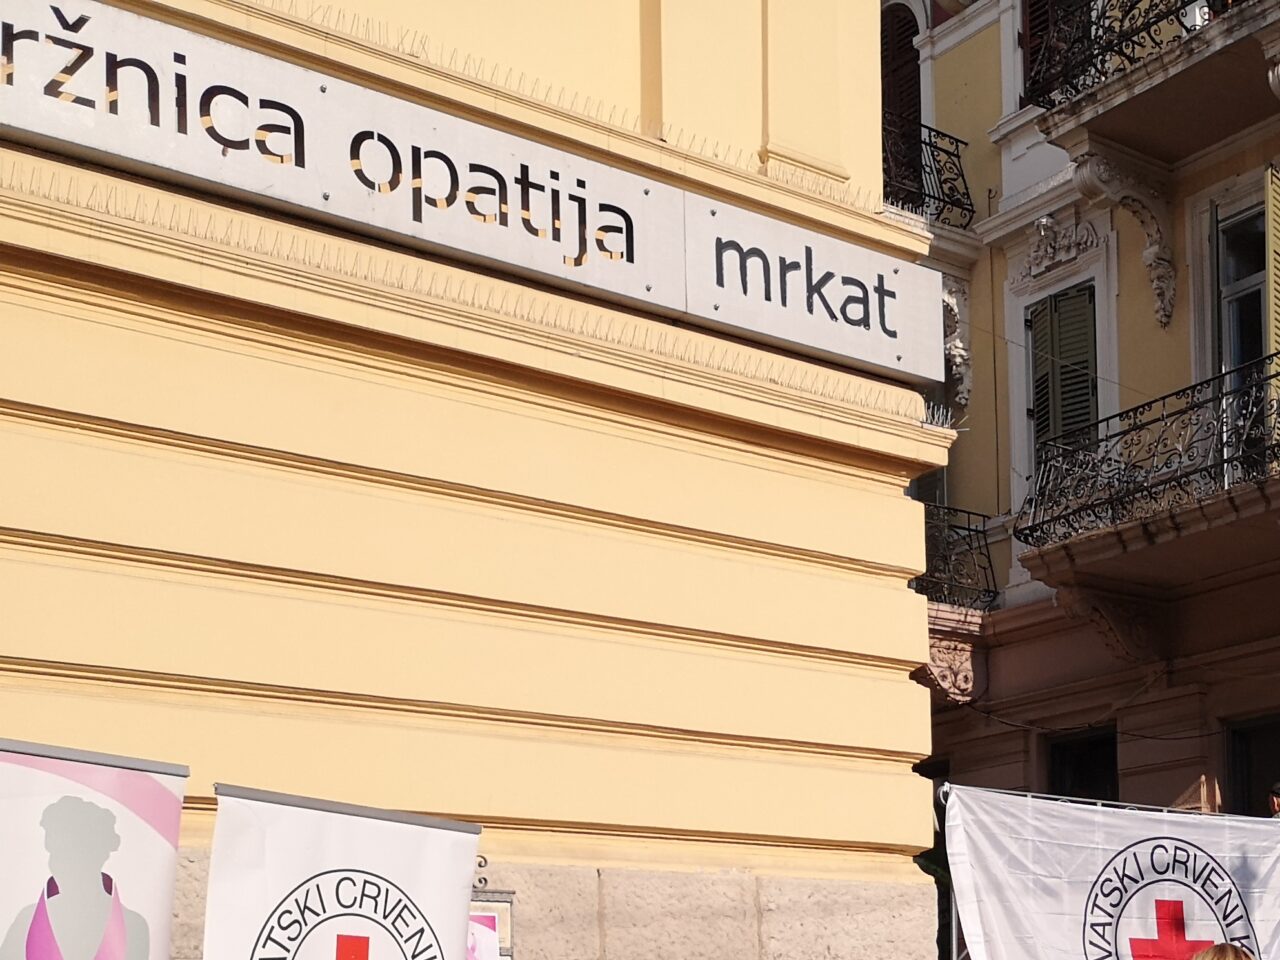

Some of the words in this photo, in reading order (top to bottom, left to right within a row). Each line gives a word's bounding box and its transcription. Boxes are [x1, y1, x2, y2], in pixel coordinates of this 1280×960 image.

[1, 5, 305, 168] ržnica
[349, 130, 635, 268] opatija
[715, 237, 898, 339] mrkat
[1150, 844, 1244, 928] CRVENI
